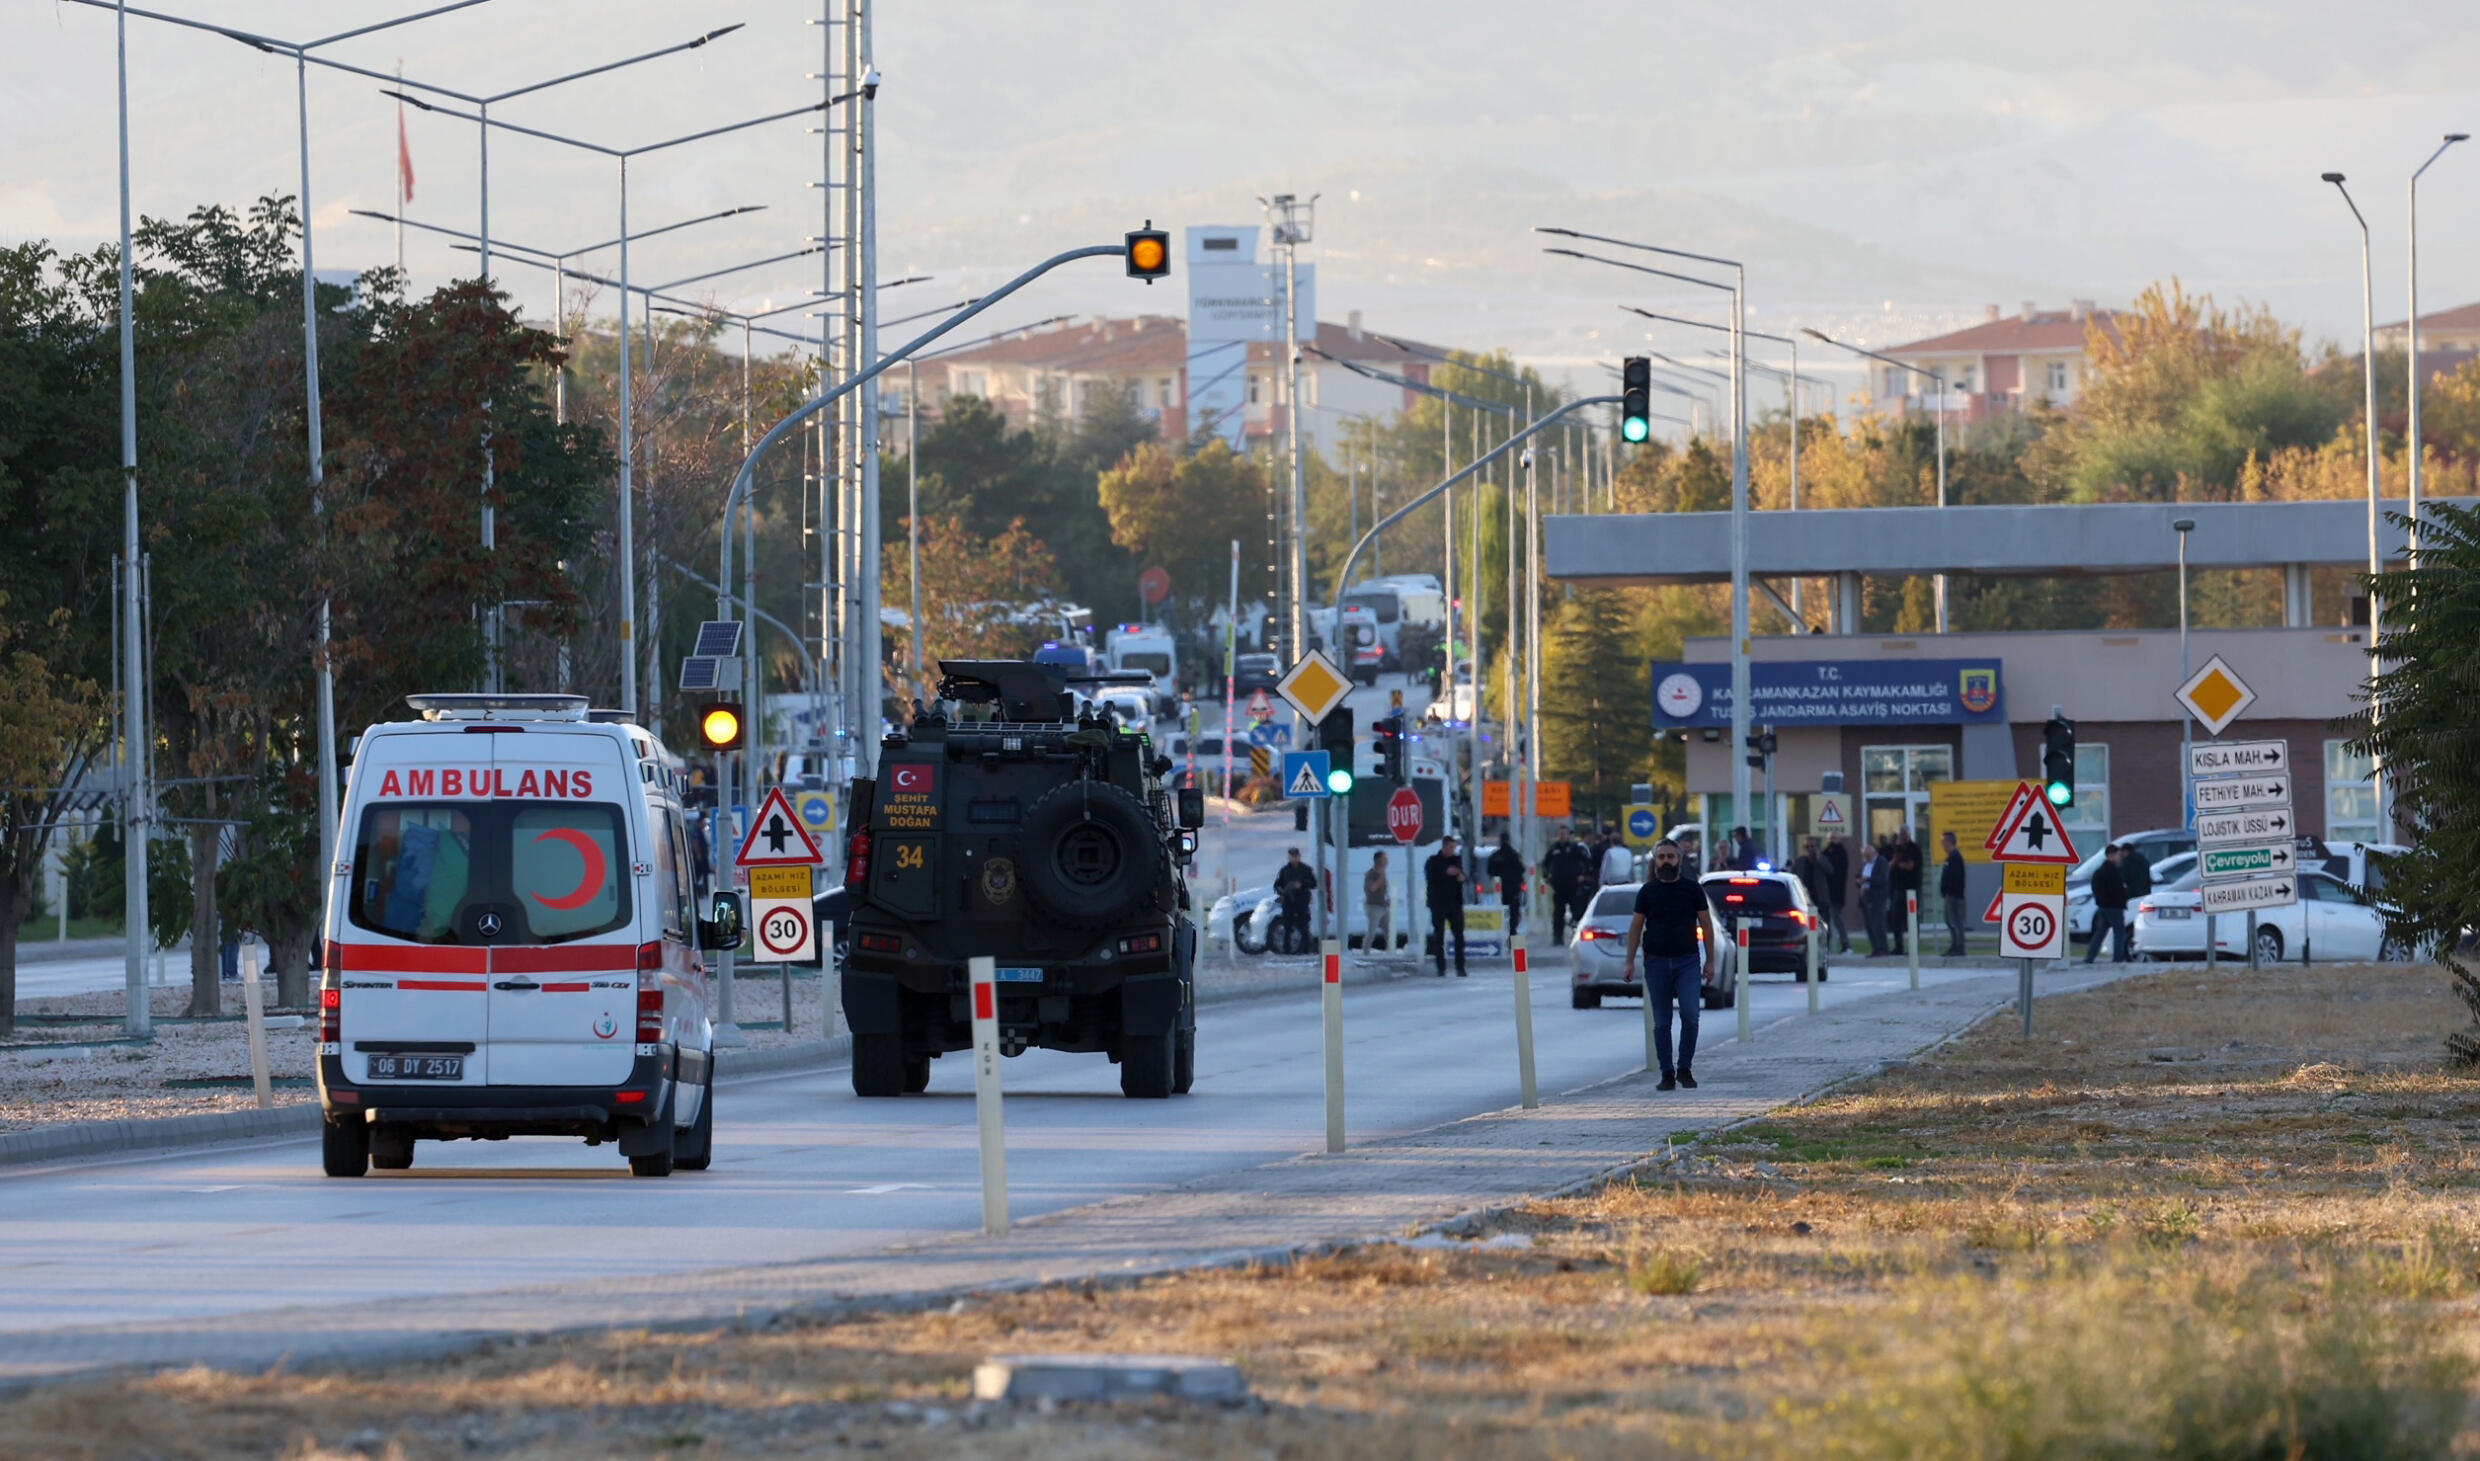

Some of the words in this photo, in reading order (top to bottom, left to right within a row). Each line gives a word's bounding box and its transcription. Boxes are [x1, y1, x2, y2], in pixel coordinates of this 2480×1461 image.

[1712, 687, 1839, 700] KAAMANKAZAN
[1759, 704, 1837, 717] JANDARMA
[379, 769, 592, 798] AMBULANS
[884, 805, 937, 816] MUSTAFA
[1391, 804, 1419, 827] DUR
[896, 844, 924, 869] 34
[2207, 852, 2270, 872] Çevreyolu
[769, 919, 797, 939] 30
[2019, 916, 2046, 935] 30
[379, 1058, 395, 1074] 06
[403, 1059, 421, 1074] DY
[427, 1059, 460, 1074] 2517
